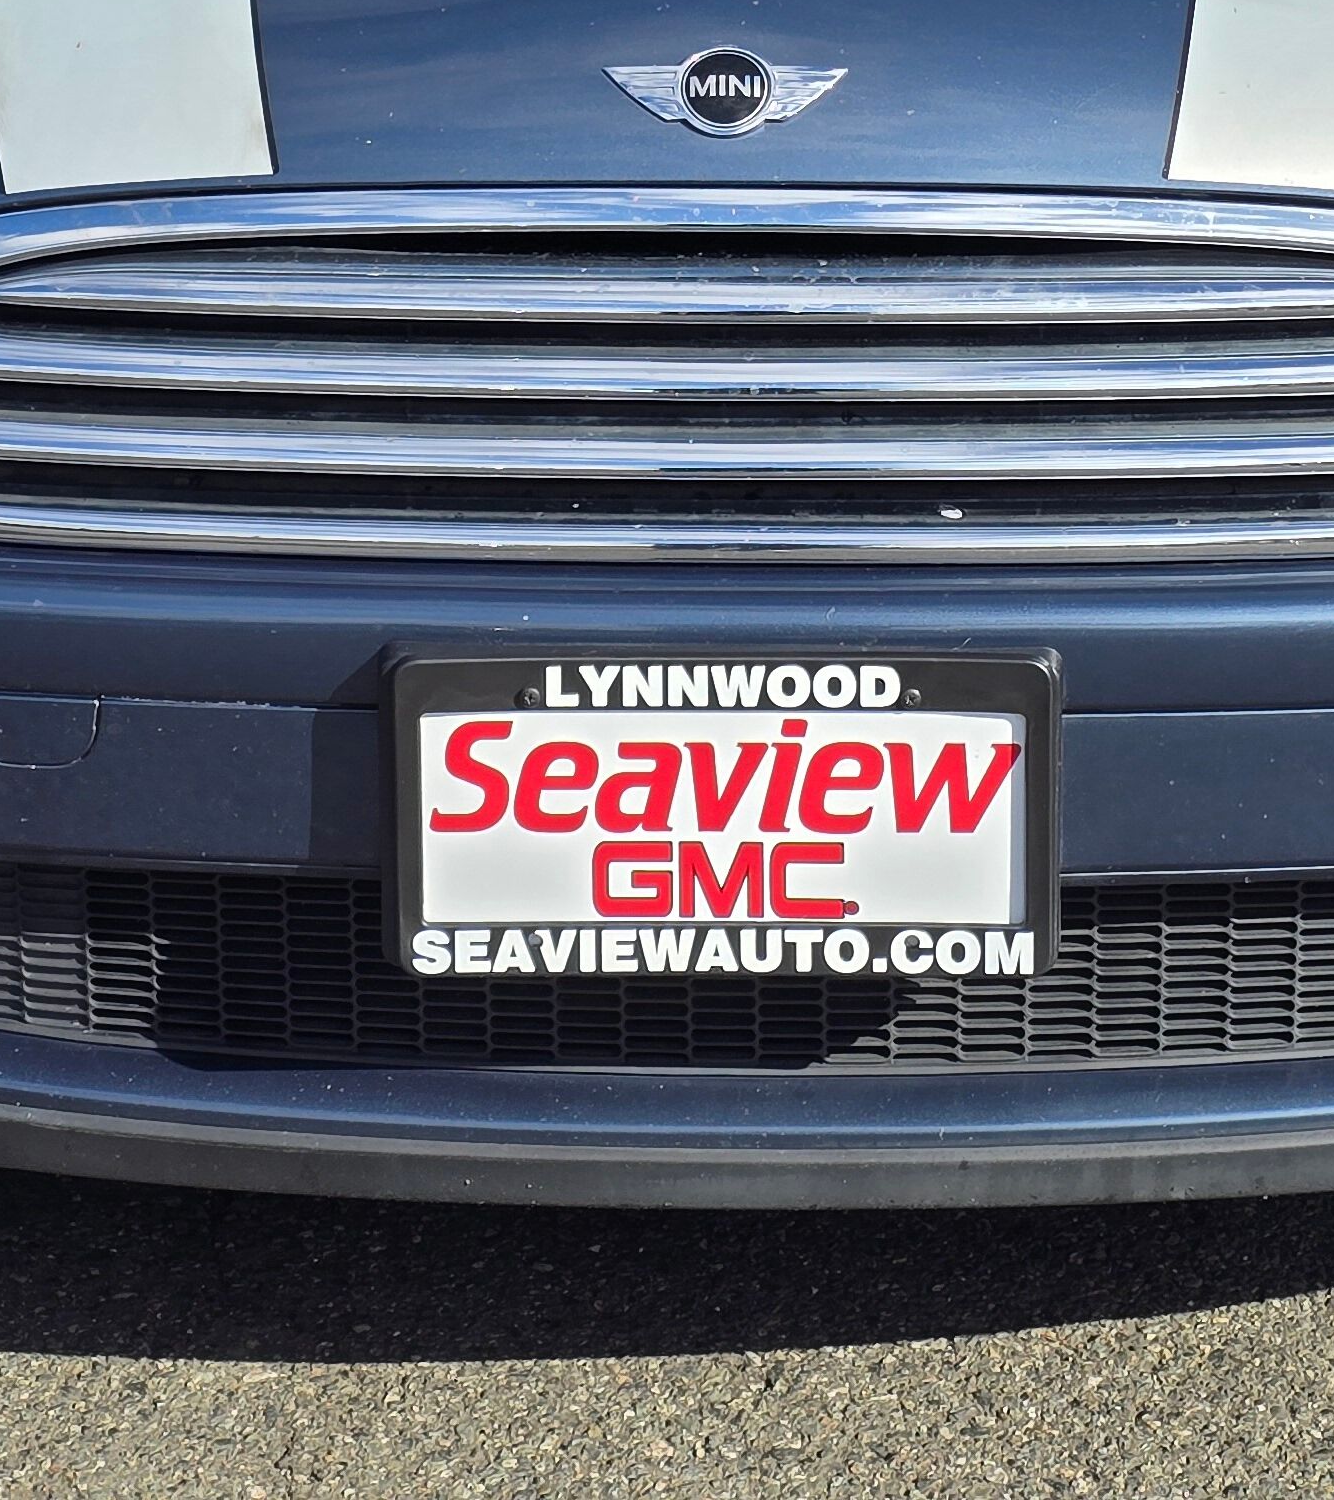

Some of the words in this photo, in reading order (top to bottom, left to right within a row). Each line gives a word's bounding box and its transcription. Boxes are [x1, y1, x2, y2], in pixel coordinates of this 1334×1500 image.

[689, 74, 761, 99] MINI
[544, 664, 901, 709] LYNNWOOD
[429, 719, 1022, 834] Seaview
[591, 841, 847, 919] GMC
[410, 928, 1036, 976] SEAVIEWAUTO.COM
